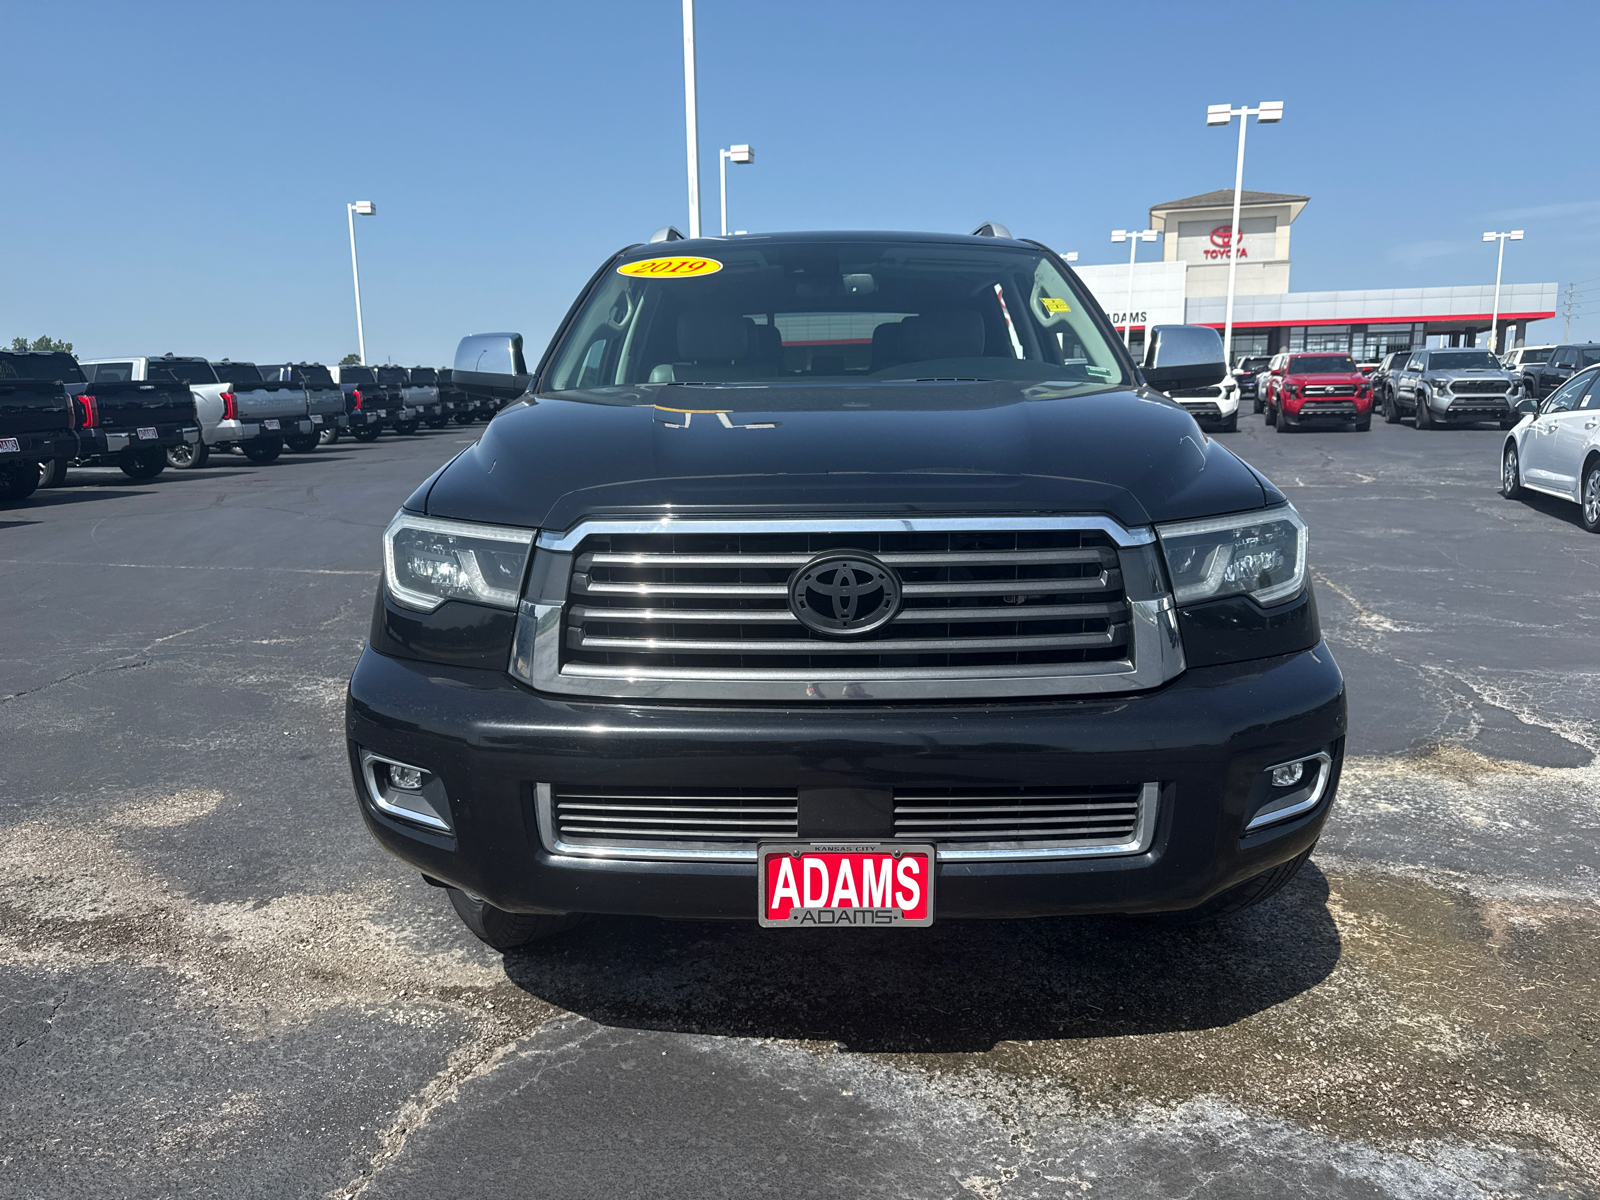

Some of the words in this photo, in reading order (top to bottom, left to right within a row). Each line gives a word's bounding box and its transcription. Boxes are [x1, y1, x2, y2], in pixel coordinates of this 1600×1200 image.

[631, 261, 707, 273] 2019
[771, 857, 921, 910] ADAMS
[800, 910, 893, 924] ADAMS
